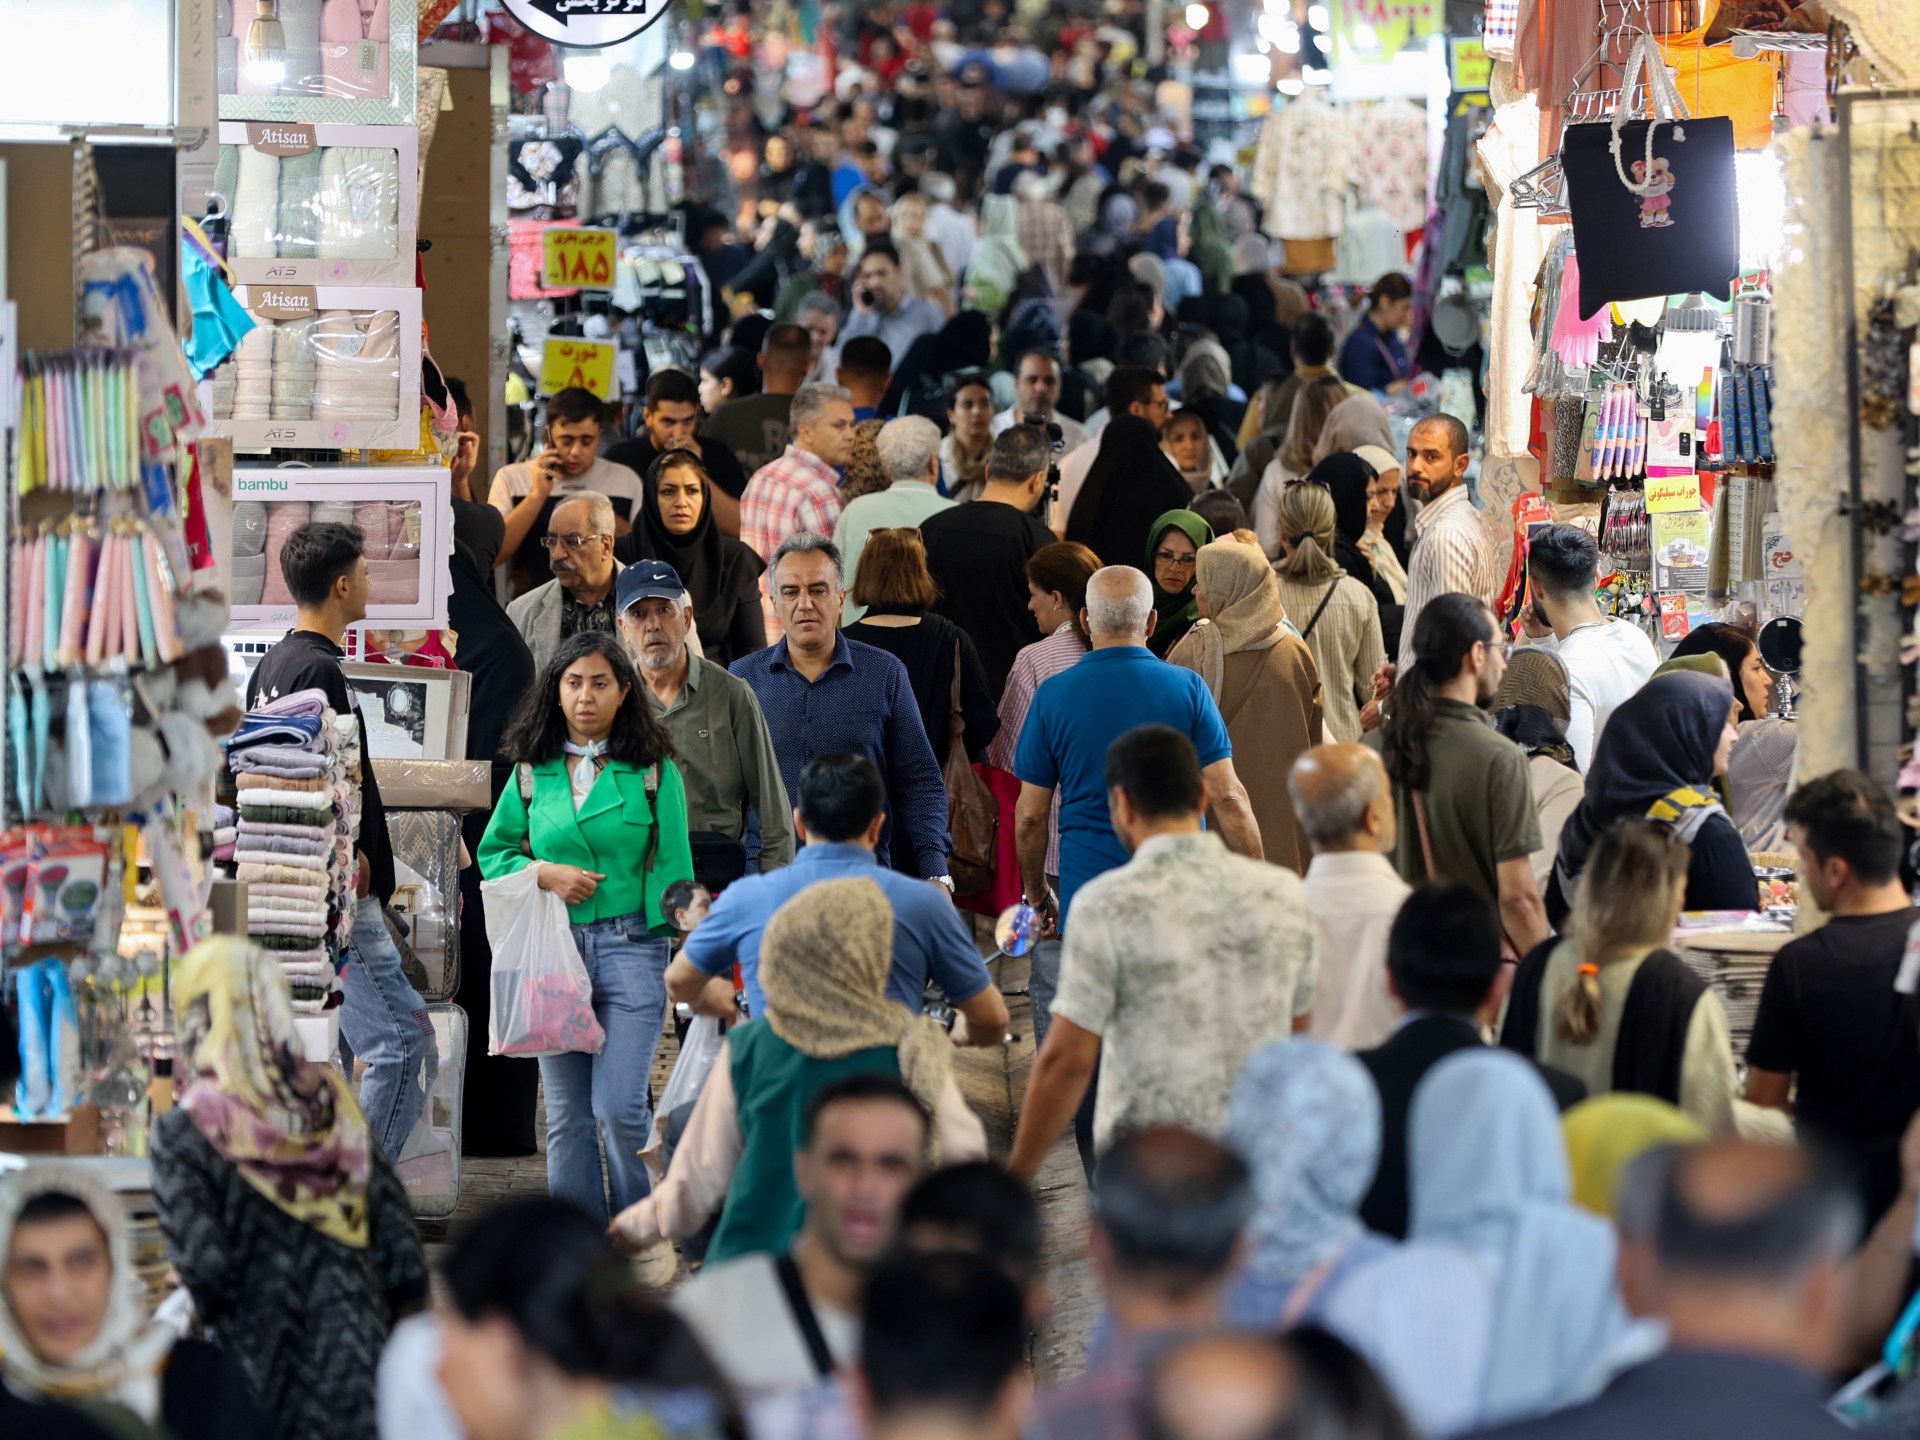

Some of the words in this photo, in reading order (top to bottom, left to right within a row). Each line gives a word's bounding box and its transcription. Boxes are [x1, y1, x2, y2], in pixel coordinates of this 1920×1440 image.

[258, 128, 308, 145] Atisan
[558, 249, 610, 283] ۱۸۵
[258, 291, 309, 309] Atisan
[560, 343, 597, 363] شورت
[238, 478, 288, 490] bambu
[1676, 485, 1697, 499] جوراب
